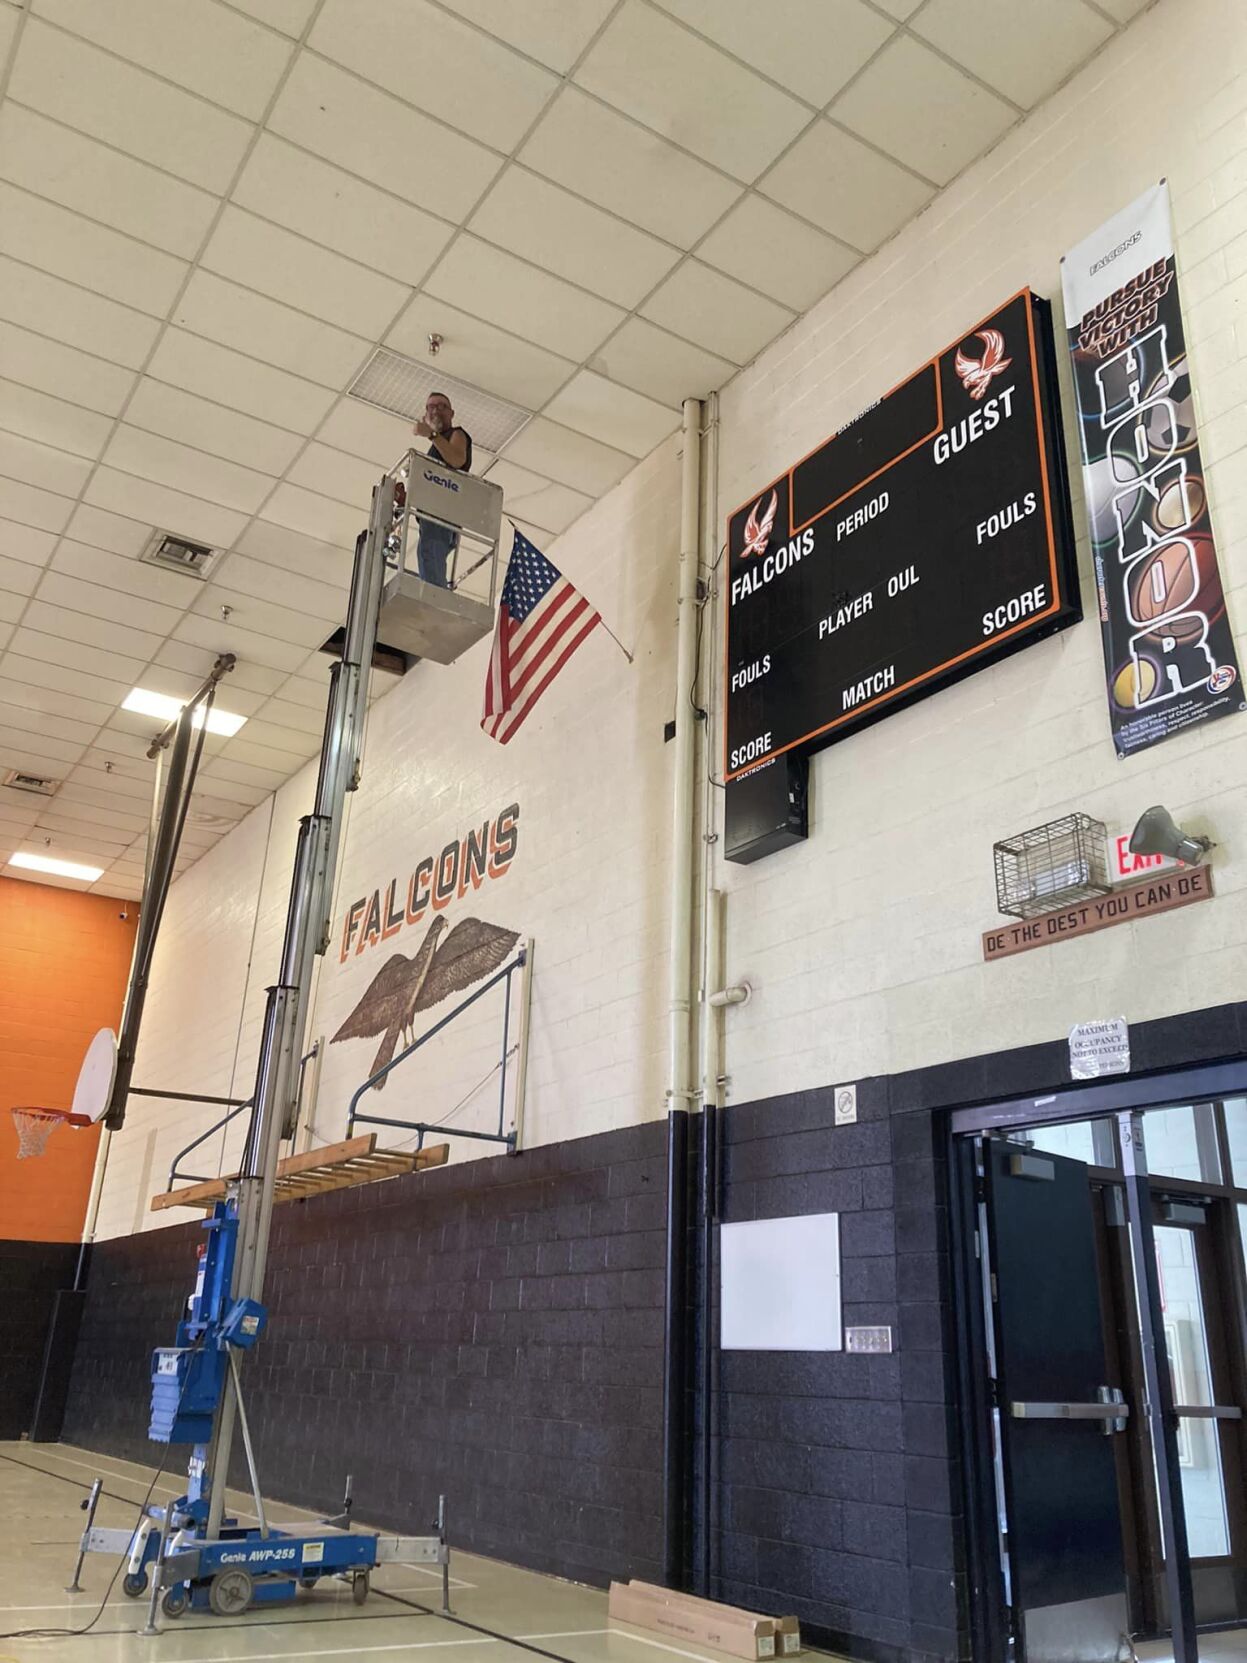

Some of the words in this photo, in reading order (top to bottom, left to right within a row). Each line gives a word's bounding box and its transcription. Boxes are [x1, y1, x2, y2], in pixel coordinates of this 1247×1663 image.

[1089, 230, 1142, 276] FALCONS
[1078, 271, 1174, 351] VICTORY
[1081, 256, 1167, 332] PURSUE
[1098, 303, 1158, 358] WITH
[933, 385, 1015, 465] GUEST
[424, 470, 459, 492] Genie
[837, 491, 889, 541] PERIOD
[976, 492, 1036, 545] FOULS
[731, 528, 814, 606] FALCONS
[819, 592, 873, 640] PLAYER
[888, 565, 920, 597] OUL
[982, 584, 1046, 635] SCORE
[731, 655, 770, 693] FOULS
[842, 665, 895, 710] MATCH
[731, 732, 772, 769] SCORE
[736, 758, 776, 782] DAKTRONICS
[340, 803, 519, 964] FALCONS
[1011, 923, 1042, 944] THE
[1095, 896, 1128, 919] YOU
[1135, 884, 1171, 908] CAN
[1074, 1035, 1121, 1049] OCCUPANCY
[1077, 1023, 1118, 1036] MAXIMUM
[220, 1552, 247, 1563] Genie
